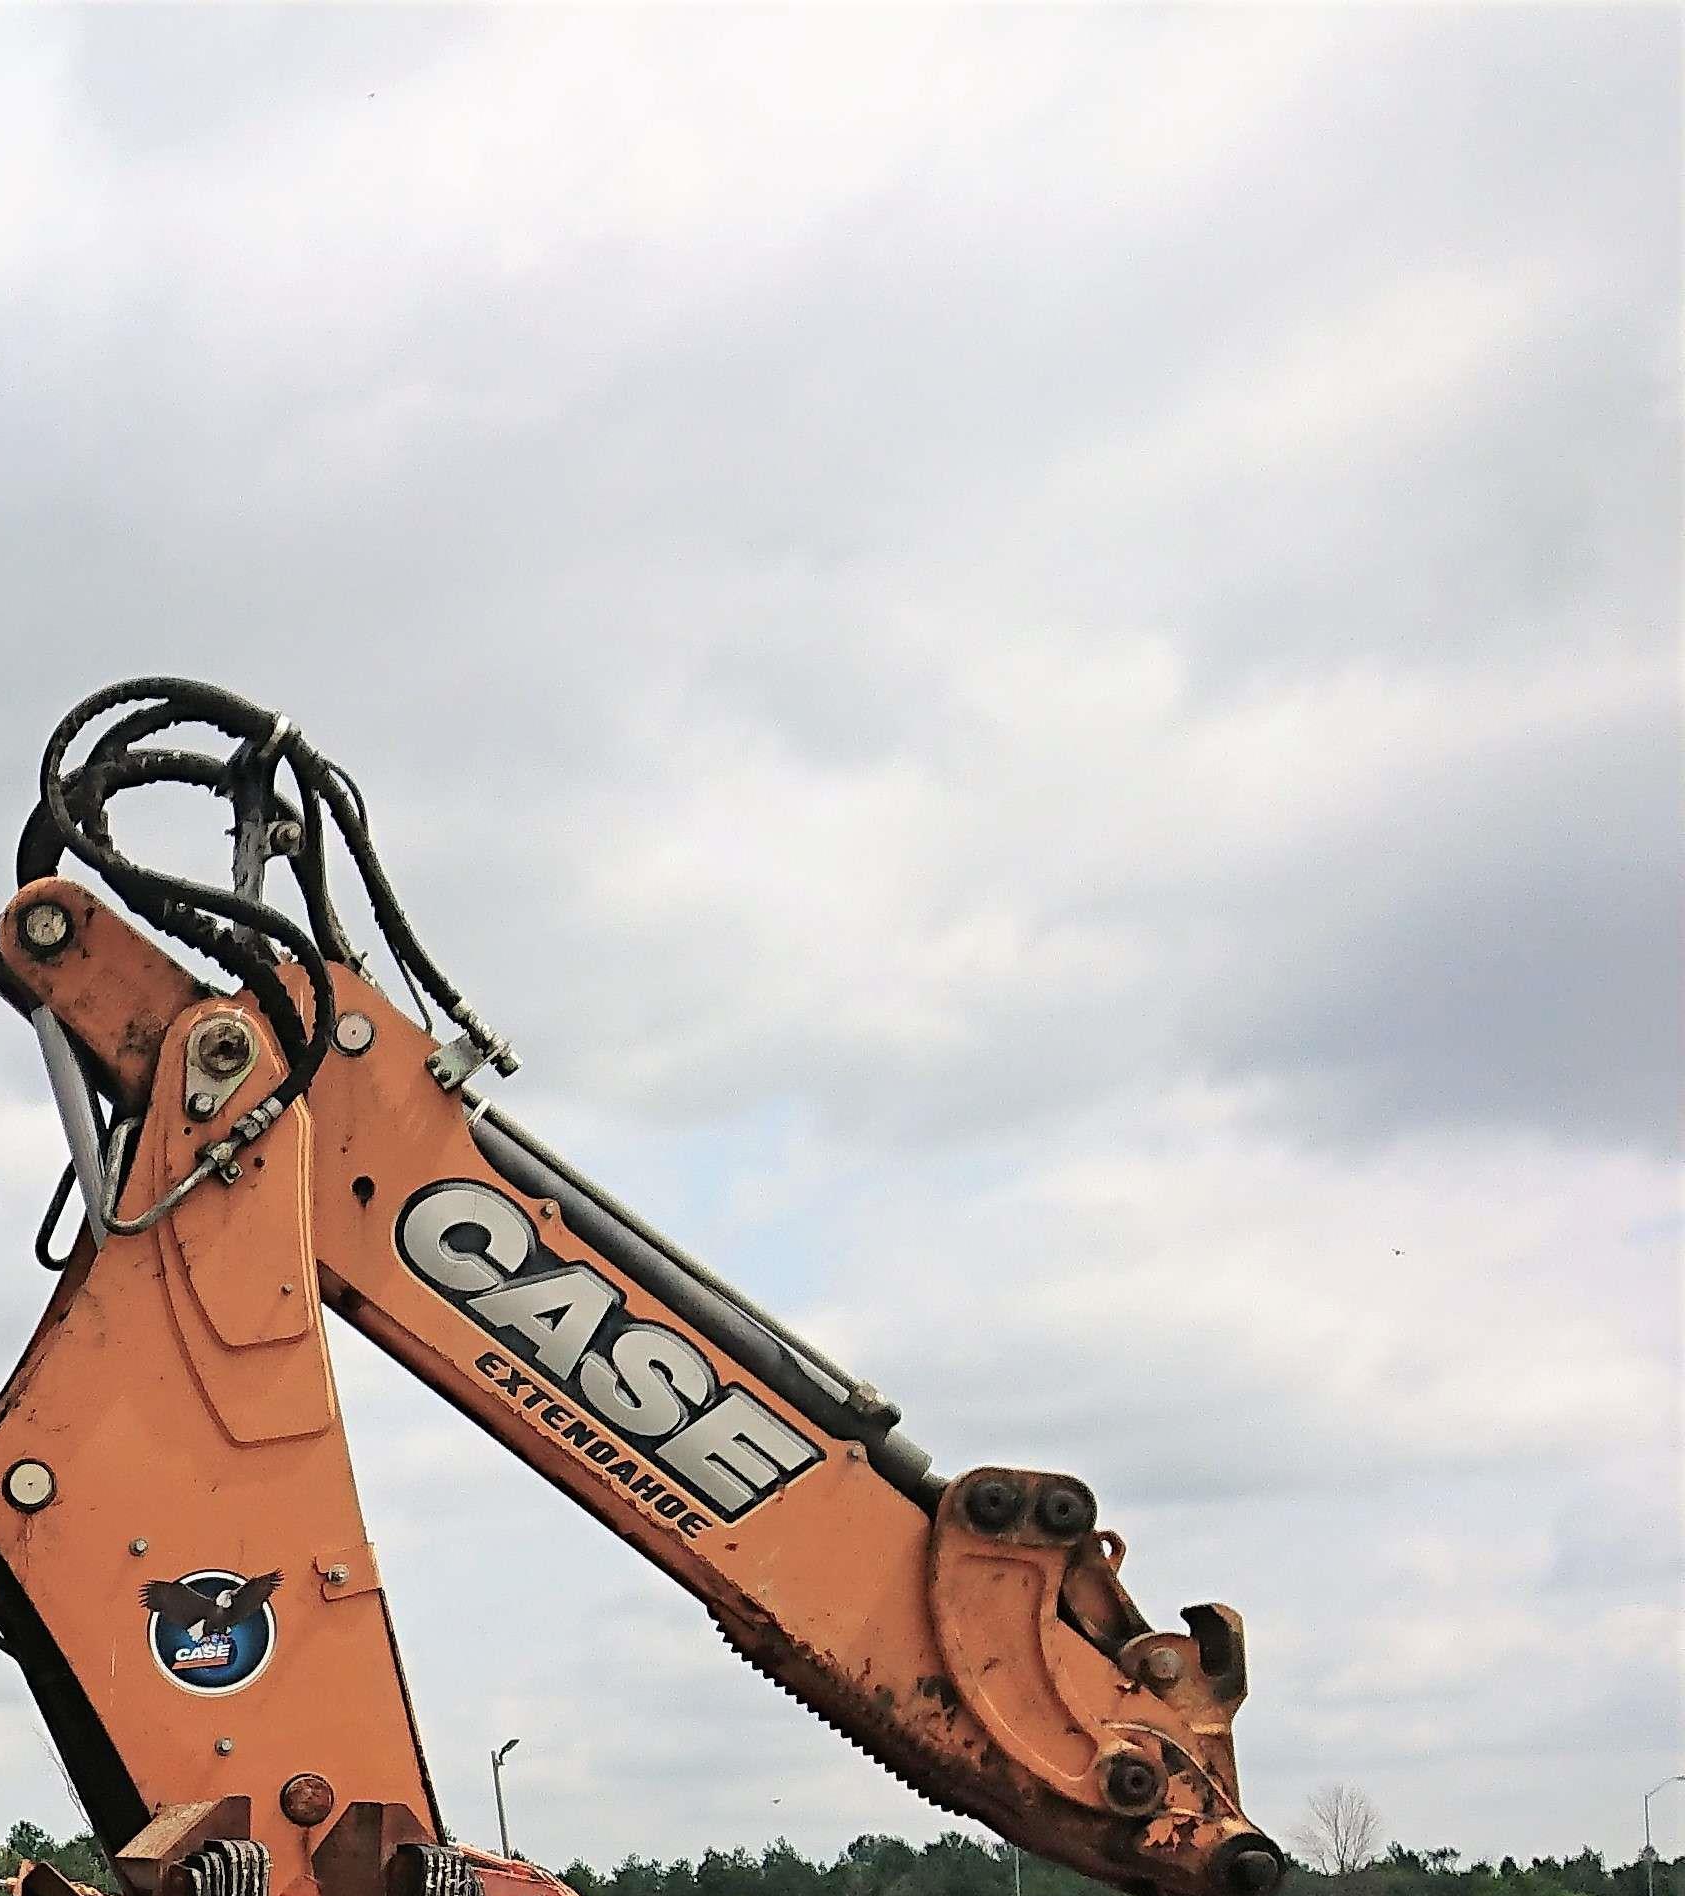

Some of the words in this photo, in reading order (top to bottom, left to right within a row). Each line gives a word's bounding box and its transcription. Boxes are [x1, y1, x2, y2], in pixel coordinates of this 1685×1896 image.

[396, 1179, 825, 1522] CASE
[474, 1351, 713, 1540] EXTENDAHOE
[175, 1643, 231, 1661] CASE
